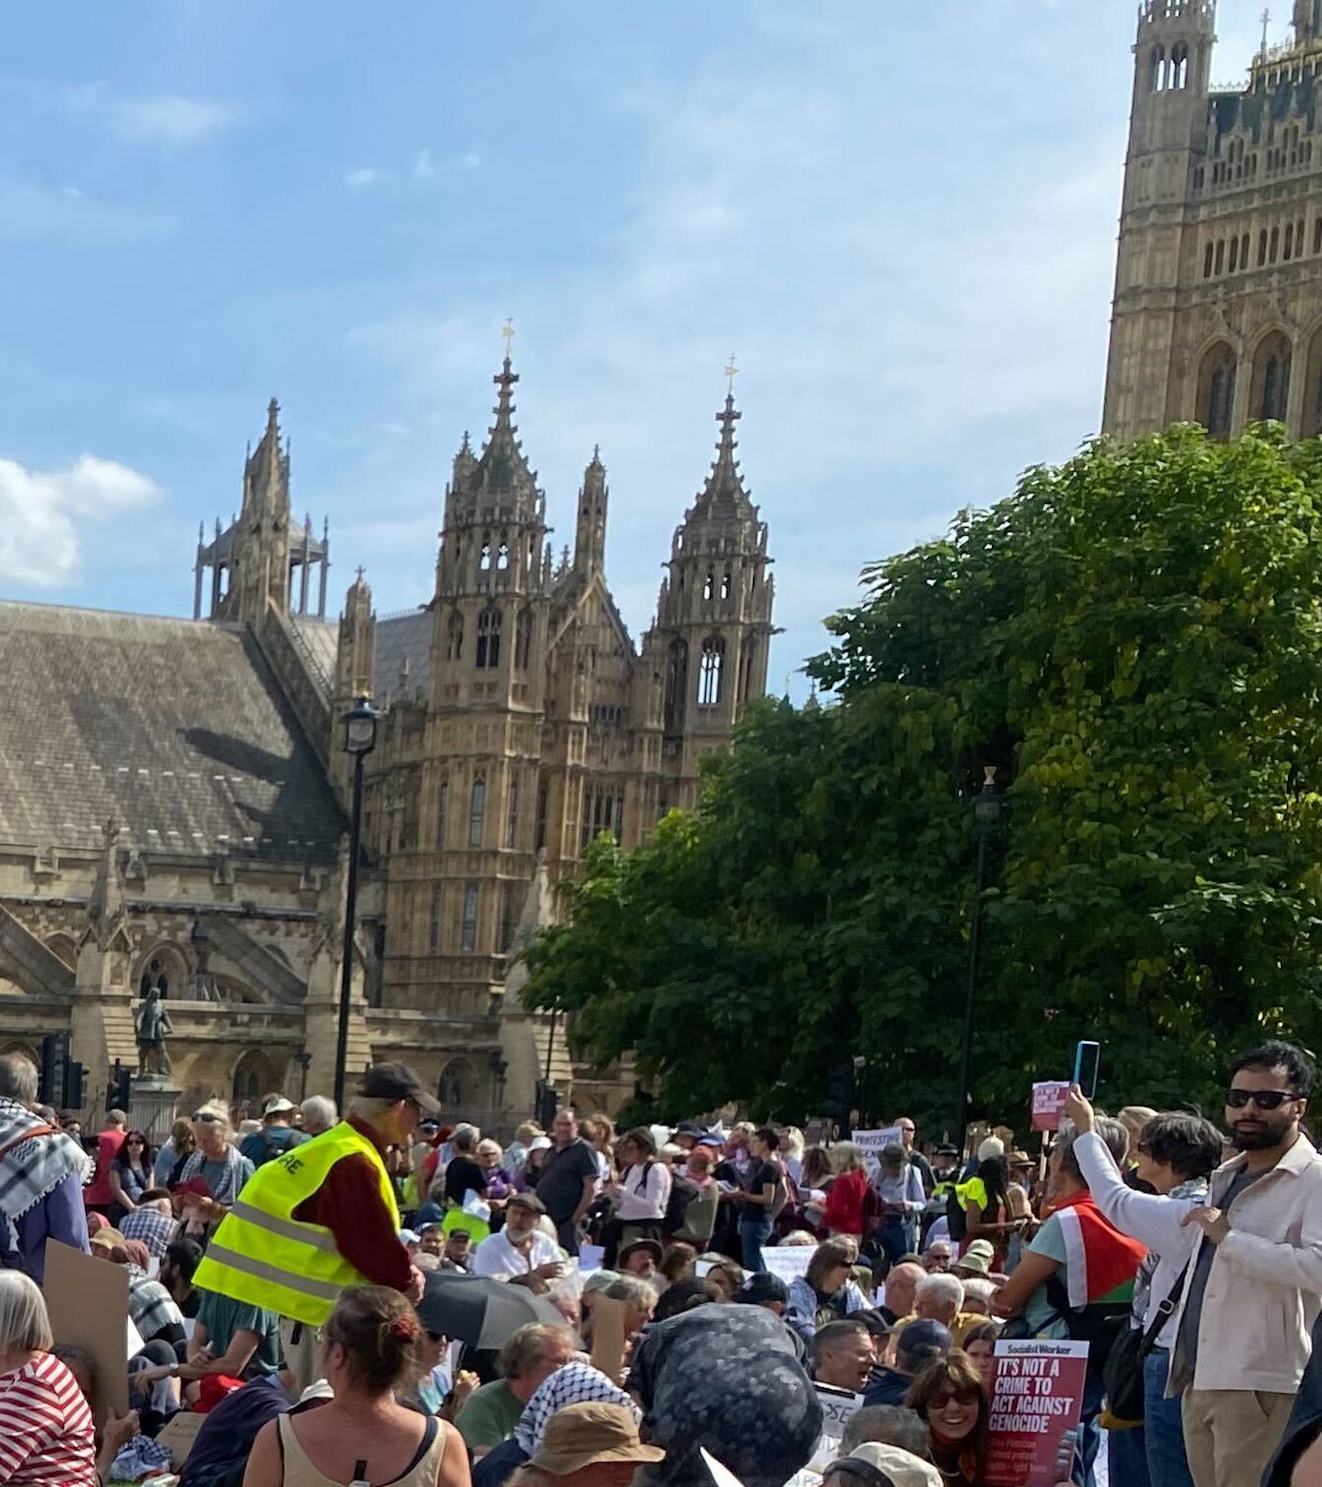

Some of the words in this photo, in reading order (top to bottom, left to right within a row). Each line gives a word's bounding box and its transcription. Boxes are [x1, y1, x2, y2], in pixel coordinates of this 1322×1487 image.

[997, 1358, 1019, 1376] IT'S
[1022, 1359, 1047, 1376] NOT
[1050, 1359, 1060, 1377] A
[994, 1377, 1031, 1395] CRIME
[1034, 1378, 1052, 1395] TO
[991, 1395, 1014, 1413] ACT
[1016, 1397, 1074, 1416] AGAINST
[989, 1414, 1050, 1433] GENOCIDE
